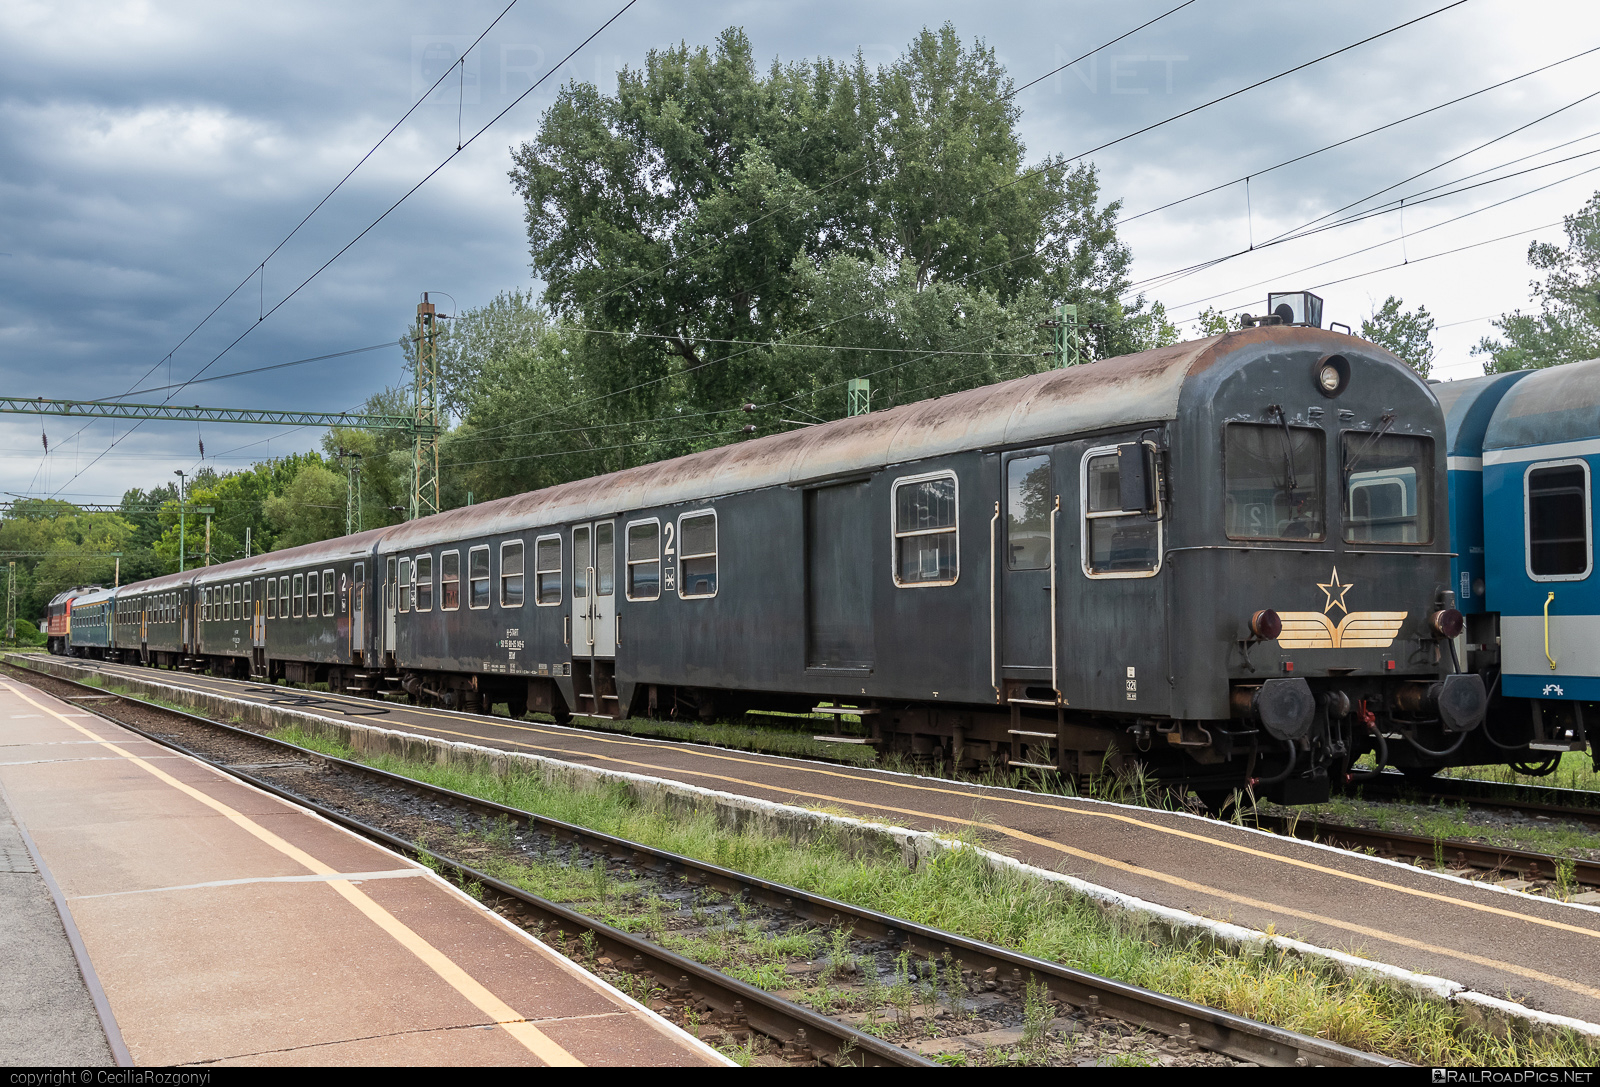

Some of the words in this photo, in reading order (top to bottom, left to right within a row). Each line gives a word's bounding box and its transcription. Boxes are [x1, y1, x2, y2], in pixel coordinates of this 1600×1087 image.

[664, 521, 675, 555] 2
[341, 572, 347, 592] 2
[411, 560, 416, 583] 2
